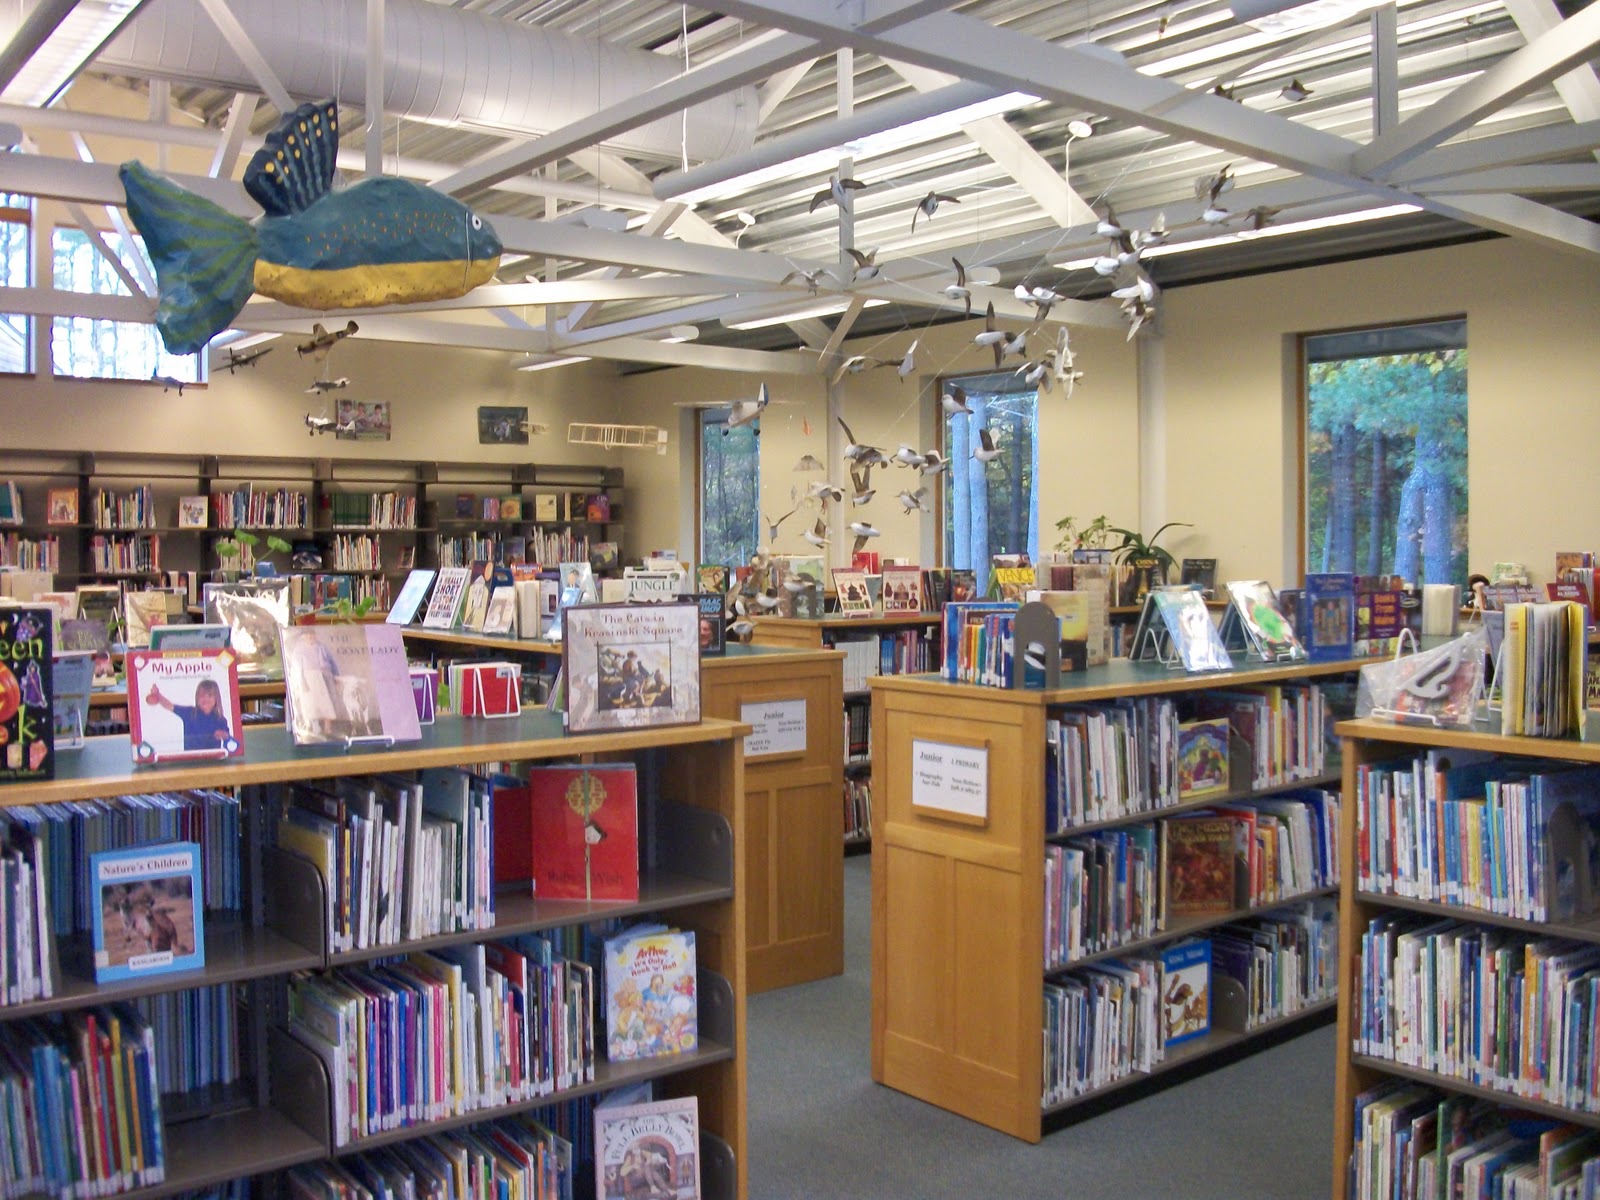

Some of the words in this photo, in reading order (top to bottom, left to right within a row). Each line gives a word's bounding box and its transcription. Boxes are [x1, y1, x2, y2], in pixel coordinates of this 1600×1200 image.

[999, 569, 1033, 581] VENICE
[435, 584, 460, 595] SHORT
[630, 580, 675, 592] JUNGLE
[602, 613, 622, 624] The
[626, 613, 649, 623] Cats
[653, 611, 665, 623] in
[584, 626, 638, 638] Krasinski
[643, 626, 683, 641] Square
[337, 646, 368, 655] GOAT
[371, 646, 399, 655] LADY
[151, 662, 172, 675] My
[175, 662, 212, 675] Apple
[763, 711, 784, 720] Junior
[920, 751, 942, 764] Junior
[955, 759, 979, 770] PRIMARY
[103, 861, 144, 875] Nature's
[147, 858, 188, 870] Children
[636, 945, 668, 959] Arthur
[631, 966, 650, 977] Rock
[662, 961, 677, 971] Roll
[634, 960, 646, 968] It's
[648, 957, 664, 965] Only
[631, 1123, 662, 1137] BELLY
